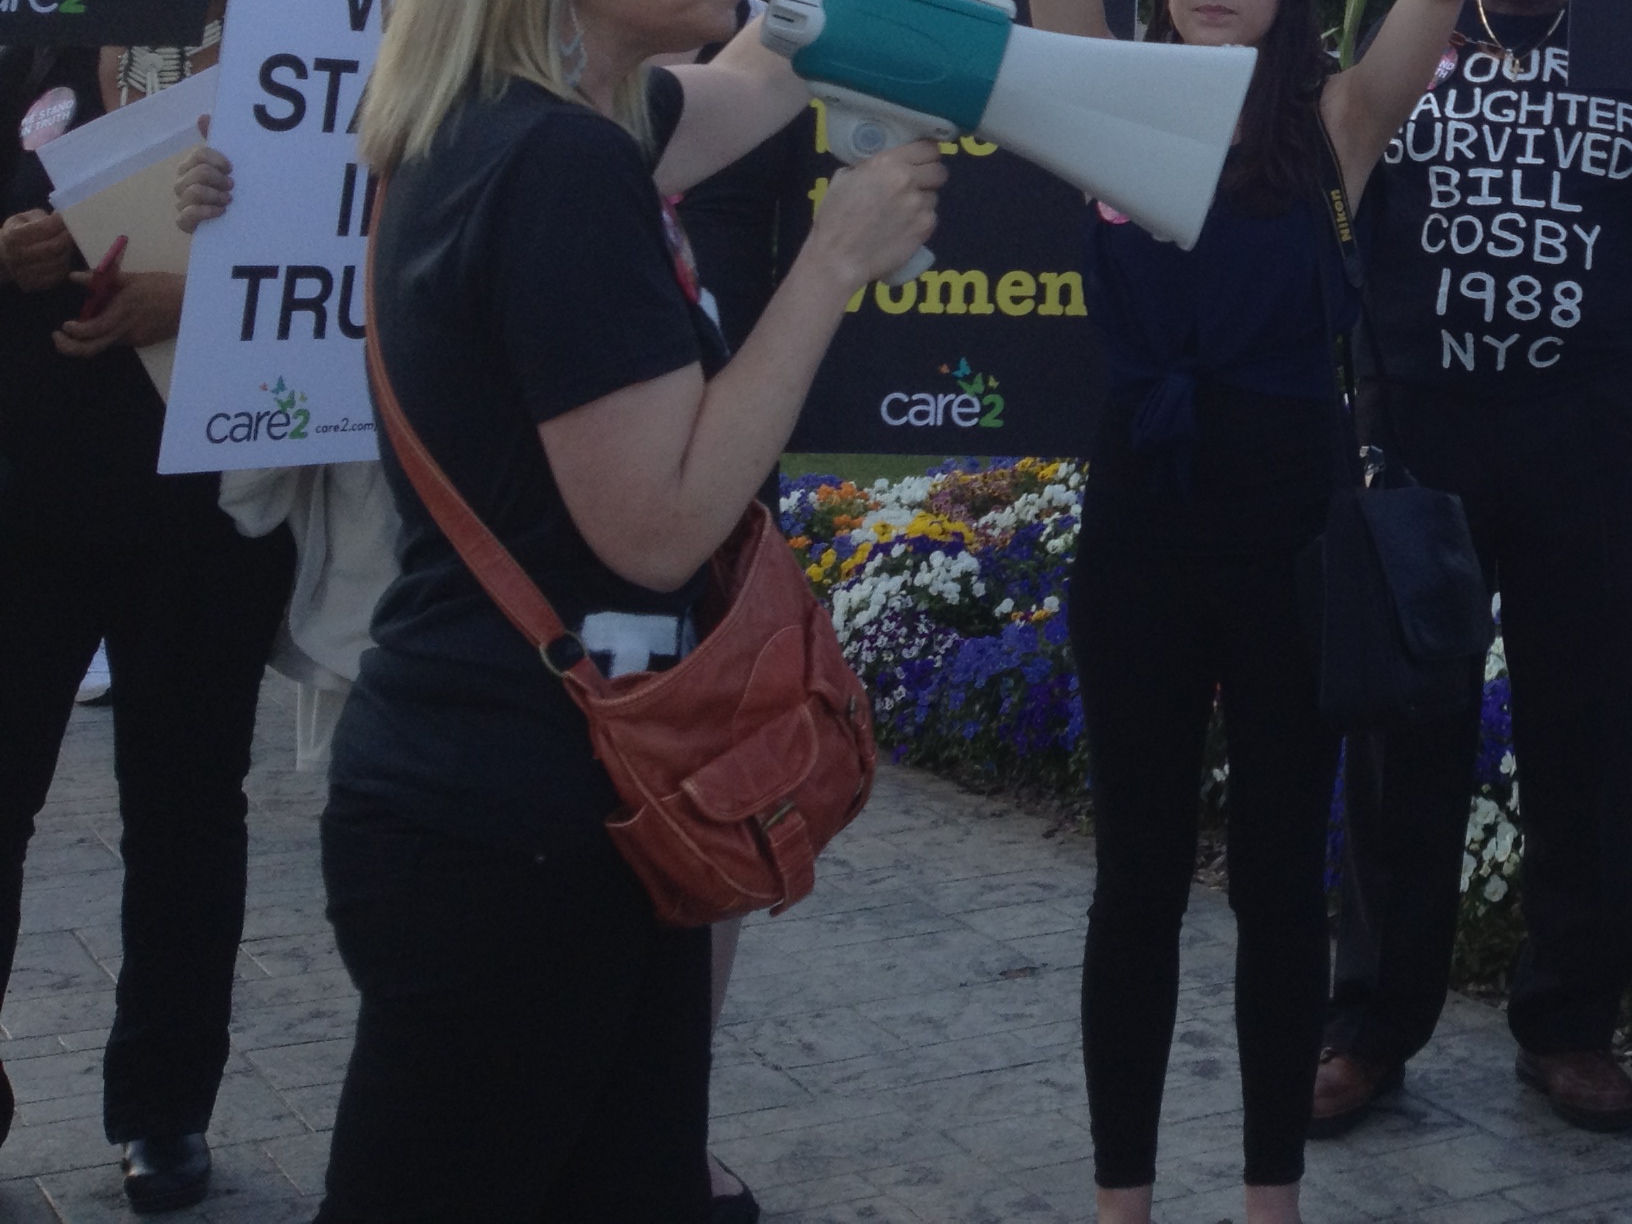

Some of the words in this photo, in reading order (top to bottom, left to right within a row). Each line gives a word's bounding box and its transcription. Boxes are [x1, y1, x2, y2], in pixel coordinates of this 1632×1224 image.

[1463, 46, 1569, 85] OUR
[1428, 165, 1583, 213] BILL
[1421, 212, 1601, 271] COSBY
[1435, 268, 1584, 329] 1988
[1441, 329, 1565, 372] NYC
[206, 408, 311, 445] care2
[880, 390, 1005, 428] care2
